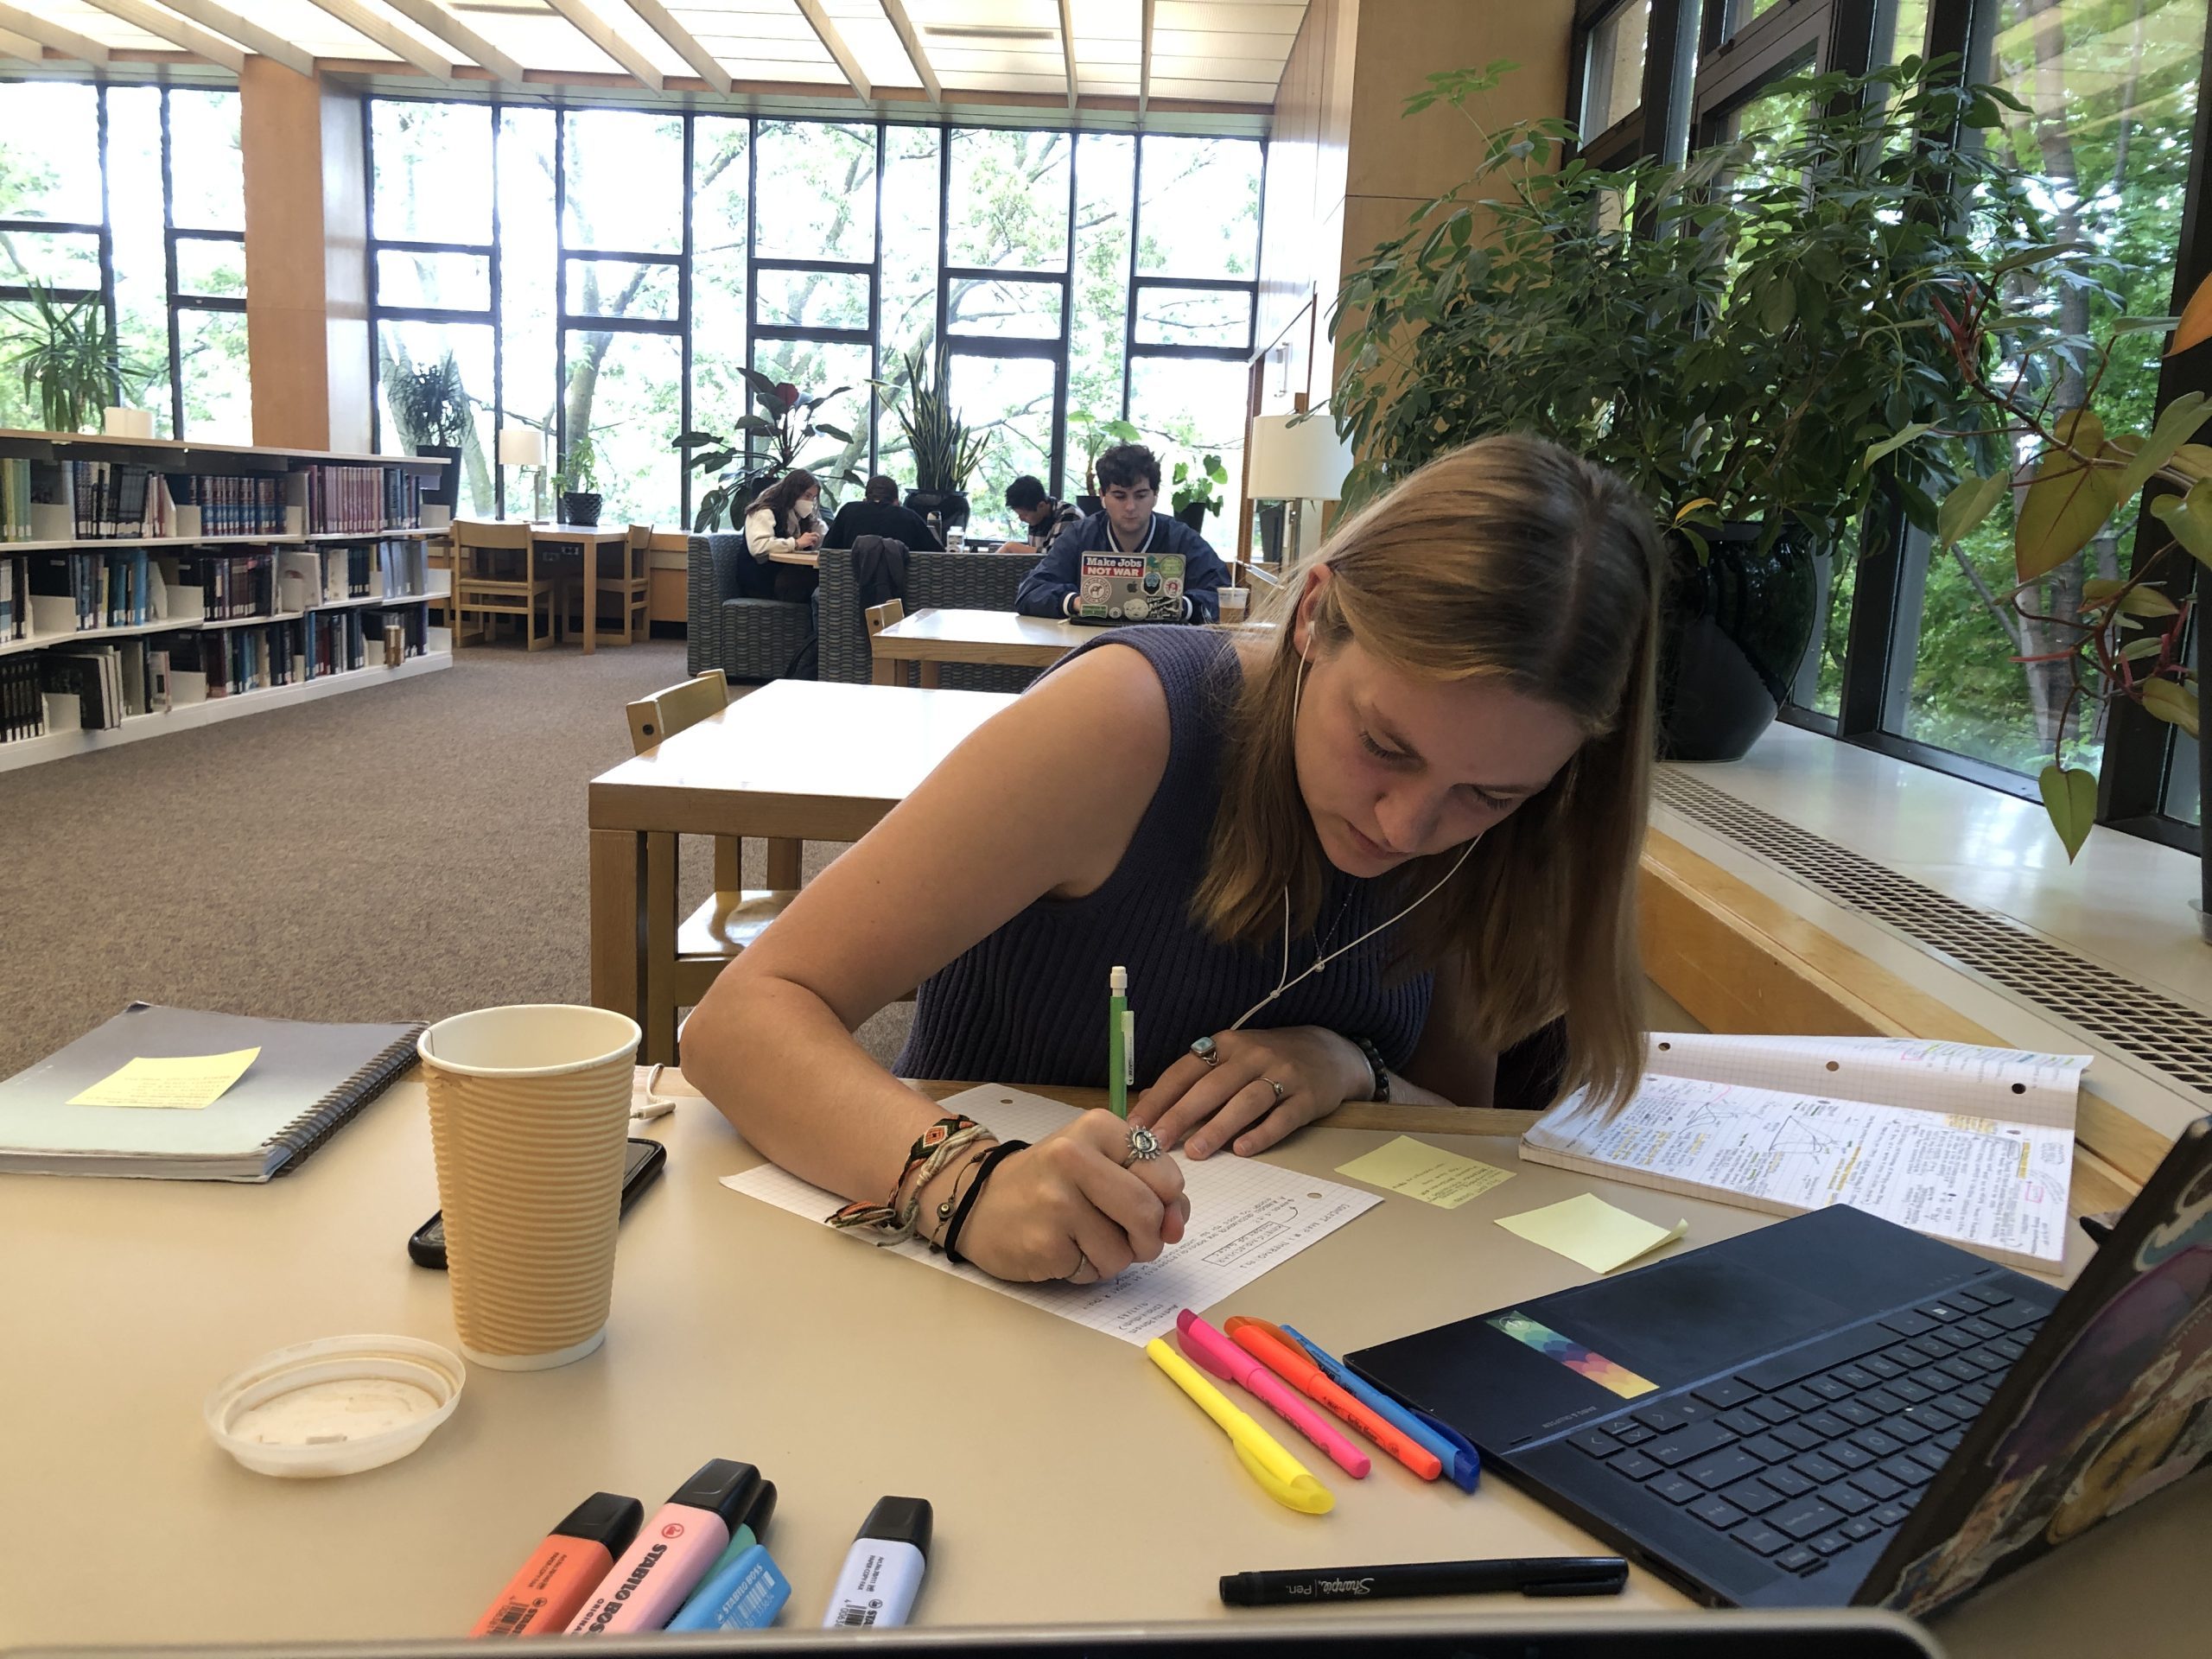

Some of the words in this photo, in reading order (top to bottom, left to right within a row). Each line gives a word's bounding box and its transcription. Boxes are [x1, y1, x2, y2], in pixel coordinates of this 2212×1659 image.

[1087, 557, 1116, 566] Make
[1118, 558, 1141, 568] Jobs
[1089, 567, 1111, 575] NOT
[1113, 568, 1139, 576] WAR
[615, 1543, 668, 1601] STABILO
[722, 1581, 748, 1615] STABILO
[746, 1562, 764, 1585] BOSS
[570, 1599, 605, 1636] ORIGINA
[586, 1601, 623, 1636] BOS
